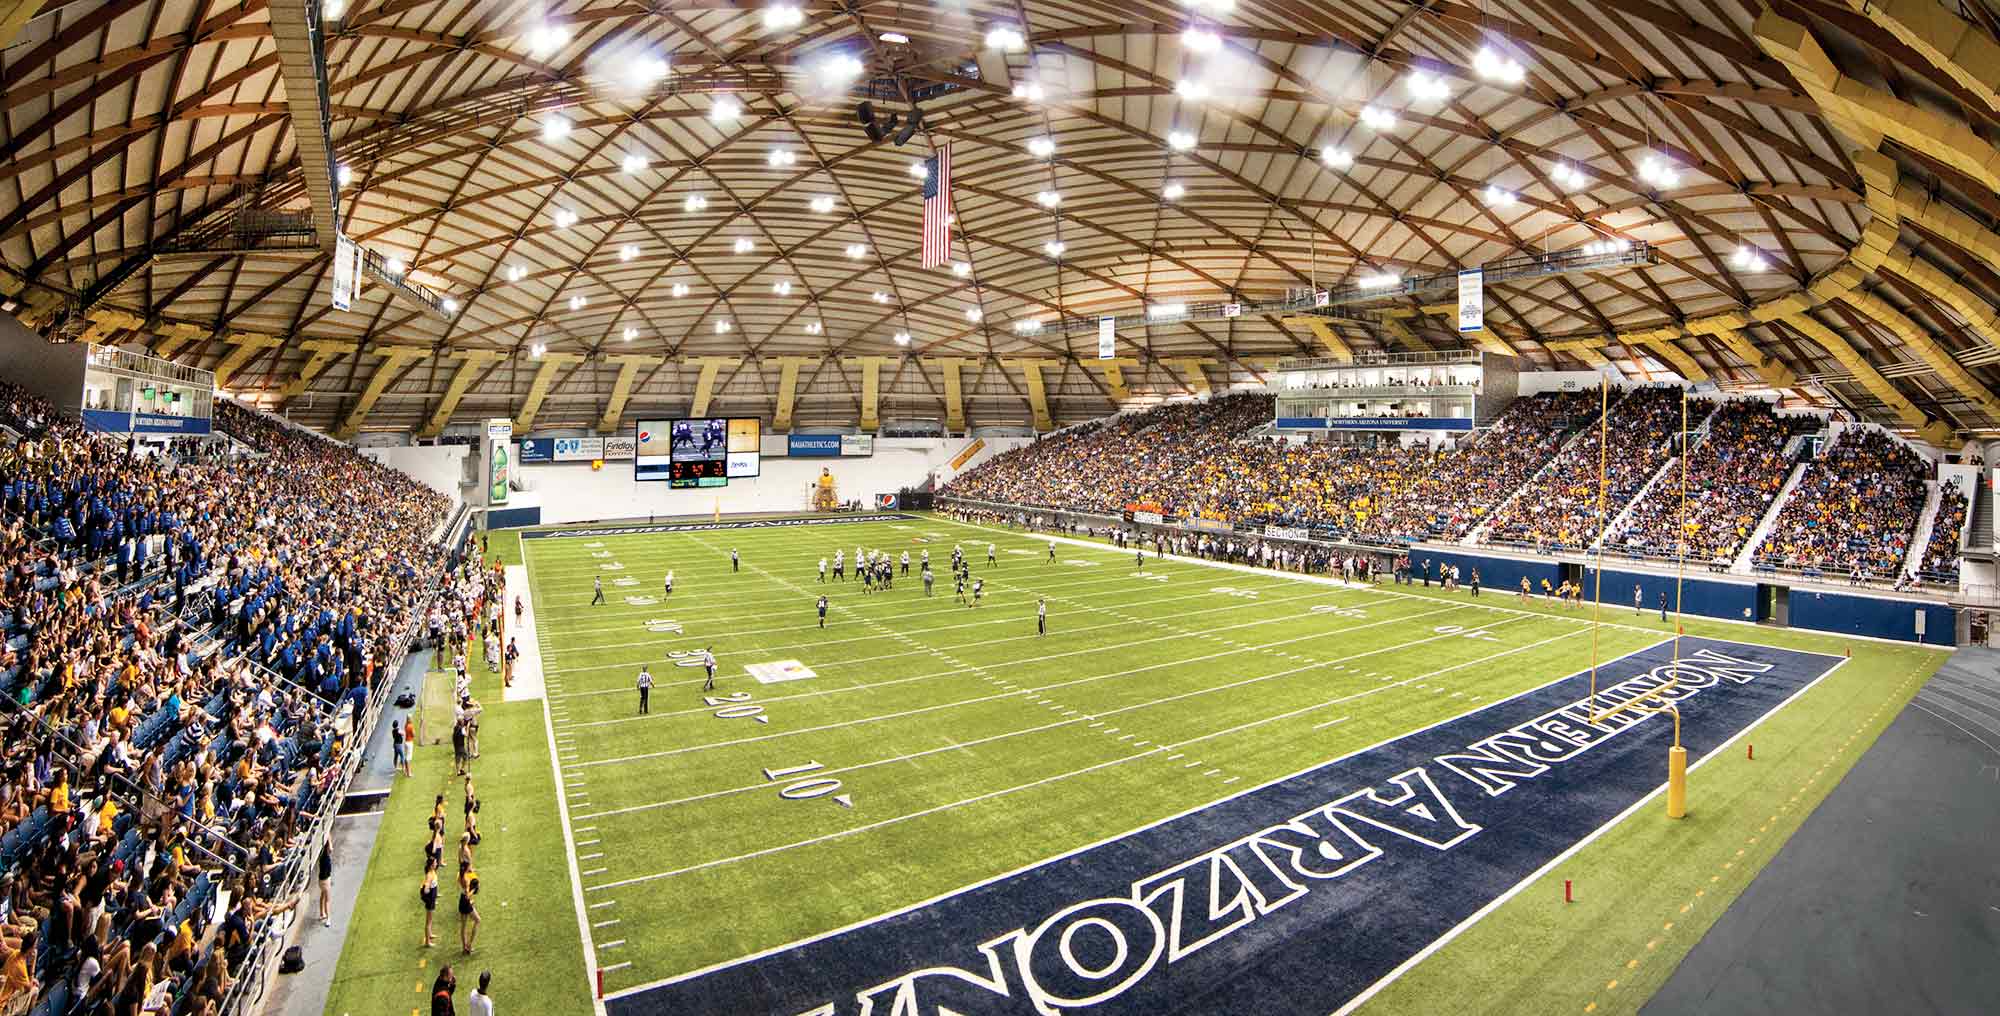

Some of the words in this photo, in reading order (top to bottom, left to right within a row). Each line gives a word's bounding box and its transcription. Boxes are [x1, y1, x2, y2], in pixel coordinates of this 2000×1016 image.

[605, 441, 636, 452] Findlay
[790, 439, 840, 449] NAUATHLETICS.COM
[1953, 474, 1964, 485] 201
[703, 691, 764, 718] 20
[1434, 648, 1775, 797] NORTHERN
[763, 759, 842, 799] 10
[797, 766, 1482, 1016] ARIZON
